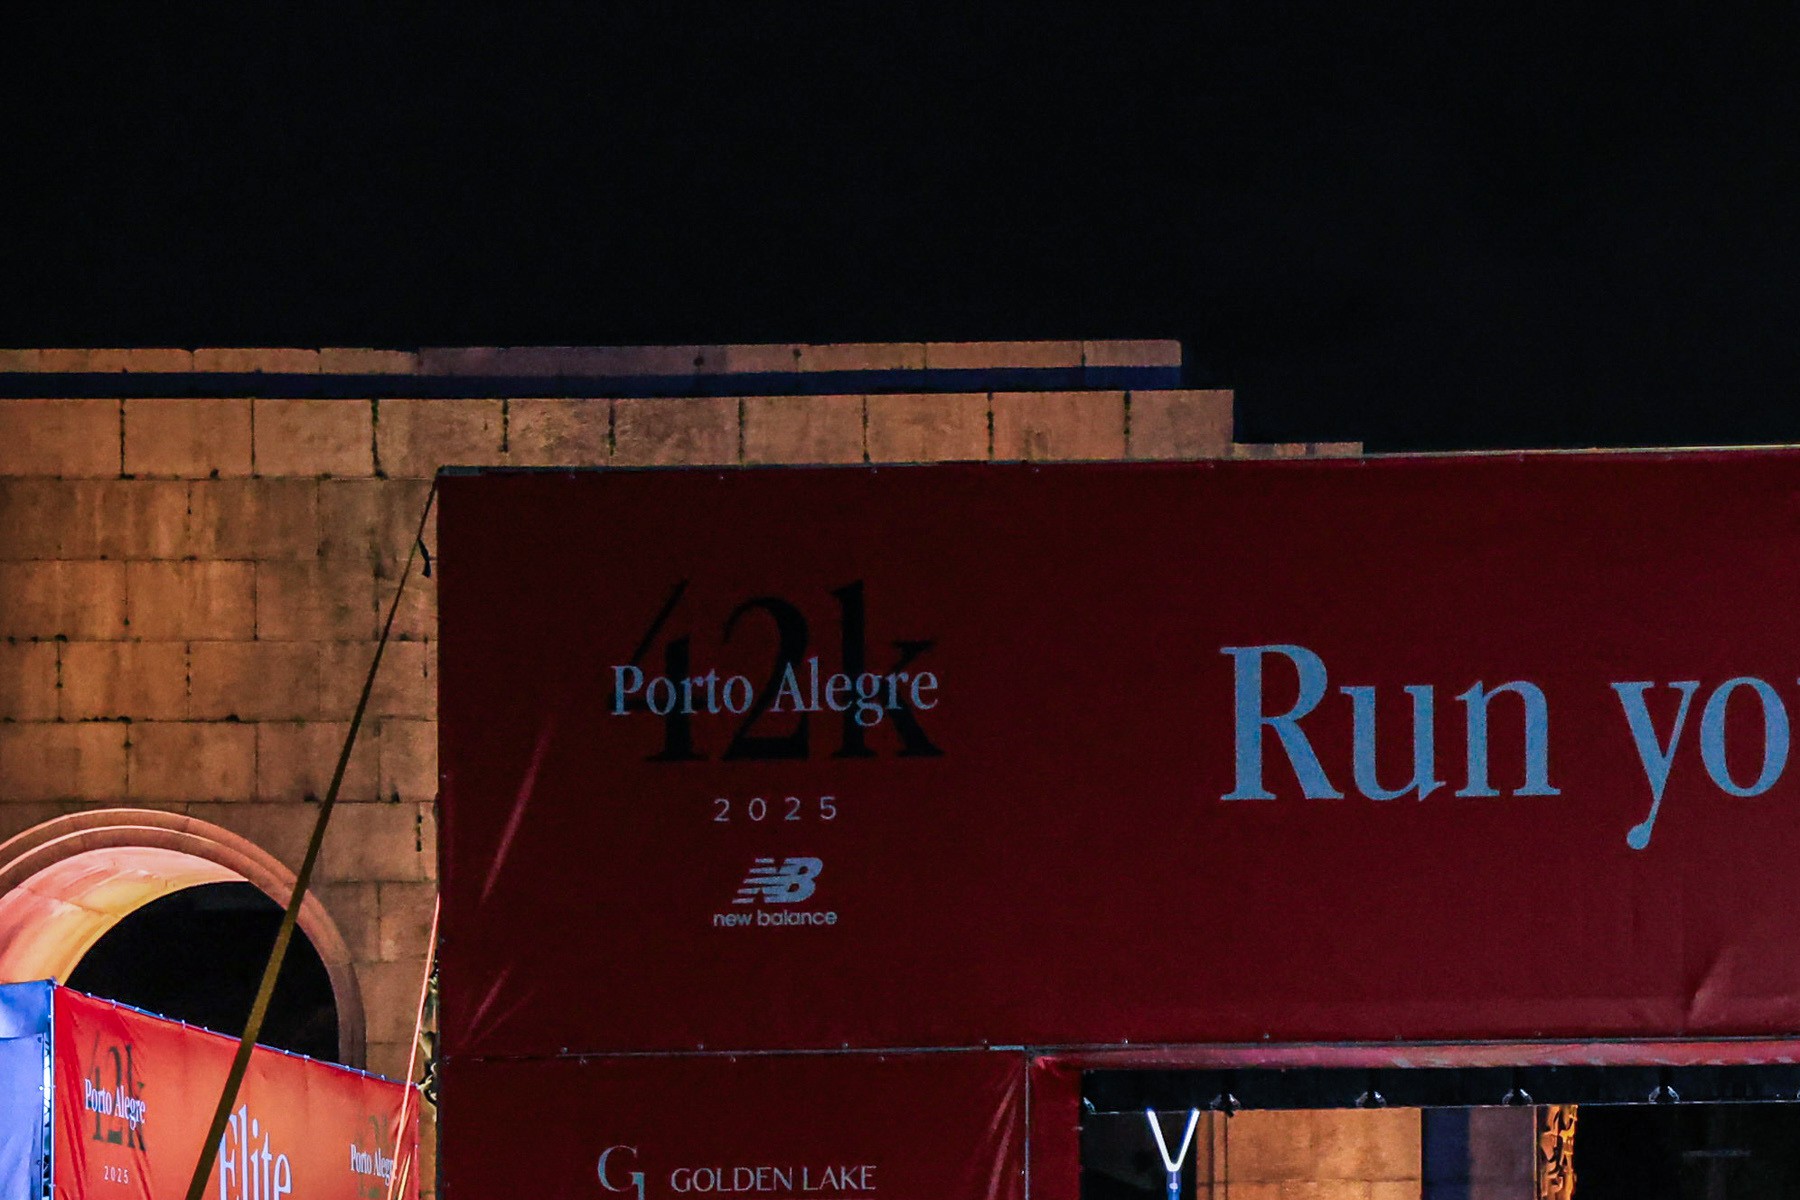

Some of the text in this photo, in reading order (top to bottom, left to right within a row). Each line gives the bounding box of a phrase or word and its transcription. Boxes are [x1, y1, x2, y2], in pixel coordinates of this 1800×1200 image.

[610, 656, 939, 727] Porto Alegre
[1219, 644, 1562, 801] Run
[713, 796, 837, 822] 2025
[713, 909, 838, 927] new balance
[84, 1077, 146, 1131] Porto Alegre
[350, 1143, 373, 1175] Porto
[104, 1165, 130, 1184] 2025
[671, 1165, 877, 1192] GOLDEN LAKE
